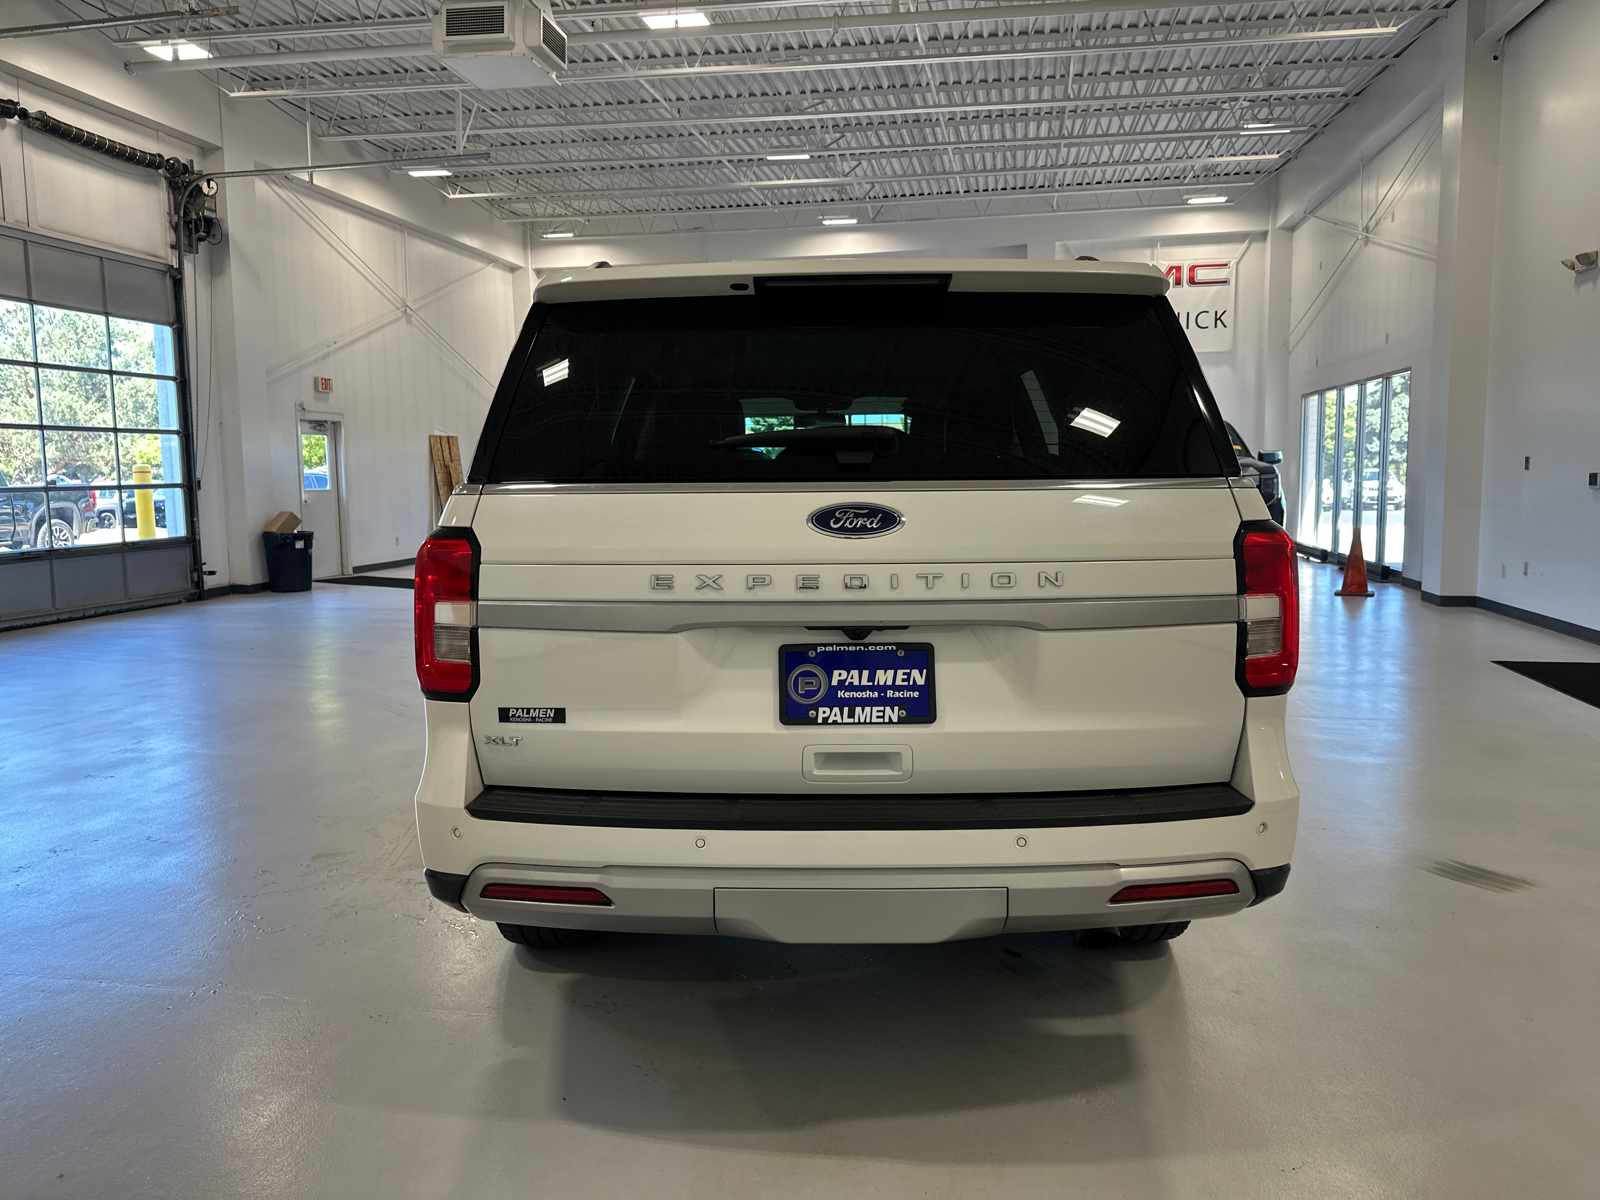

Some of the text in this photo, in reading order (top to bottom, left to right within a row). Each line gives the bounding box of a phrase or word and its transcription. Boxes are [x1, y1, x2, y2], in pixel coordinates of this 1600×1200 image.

[1176, 310, 1228, 330] ICK
[321, 378, 331, 390] EXIT
[830, 508, 882, 528] Ford
[650, 571, 1064, 590] EXPEDITION
[831, 669, 927, 686] PALMEN
[837, 690, 878, 698] Kenosha
[887, 690, 919, 698] Racine
[509, 708, 555, 718] PALMEN
[817, 706, 899, 723] PALMEN
[484, 735, 522, 747] XLT
